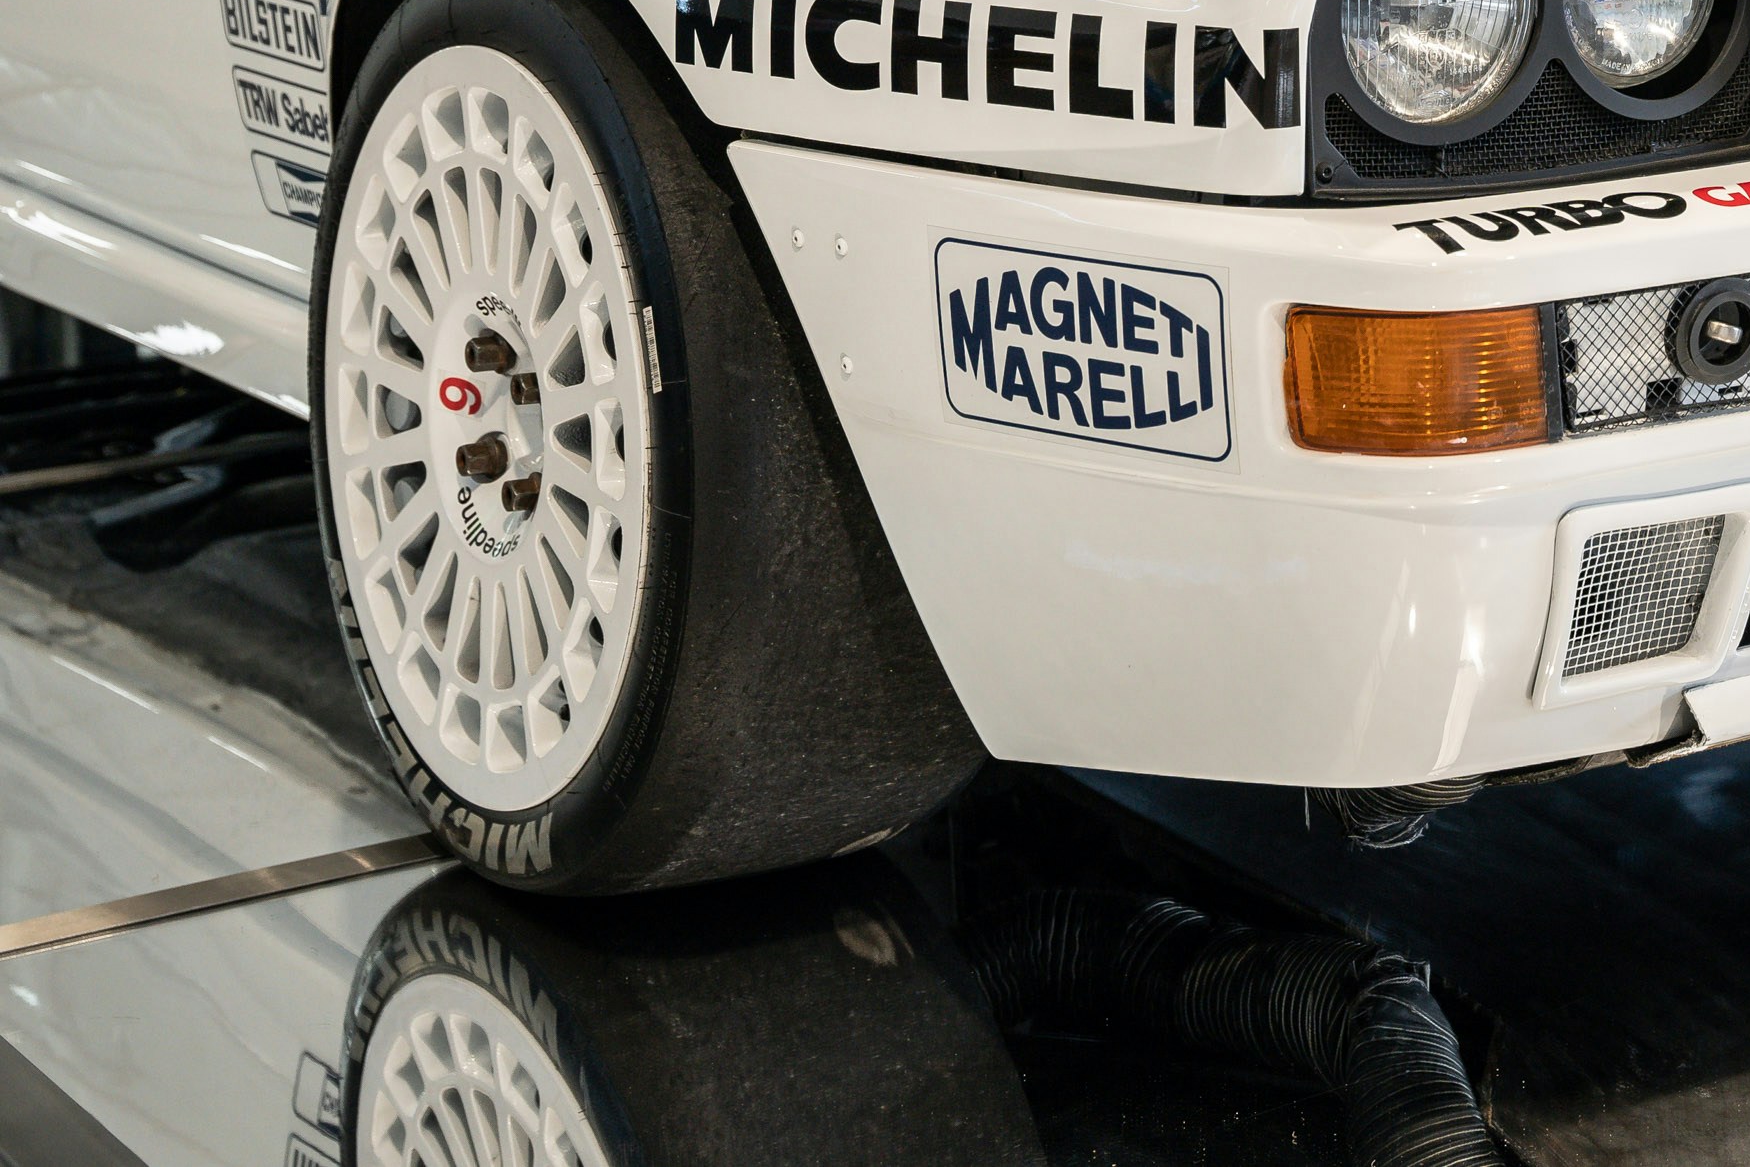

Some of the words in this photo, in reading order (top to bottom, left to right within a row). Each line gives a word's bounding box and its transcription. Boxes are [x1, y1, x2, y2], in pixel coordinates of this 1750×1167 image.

[237, 78, 280, 128] TRW
[1393, 190, 1688, 255] TURBO
[949, 266, 1213, 374] MAGNETI
[951, 329, 1213, 431] MARELLI
[457, 486, 521, 558] speedline
